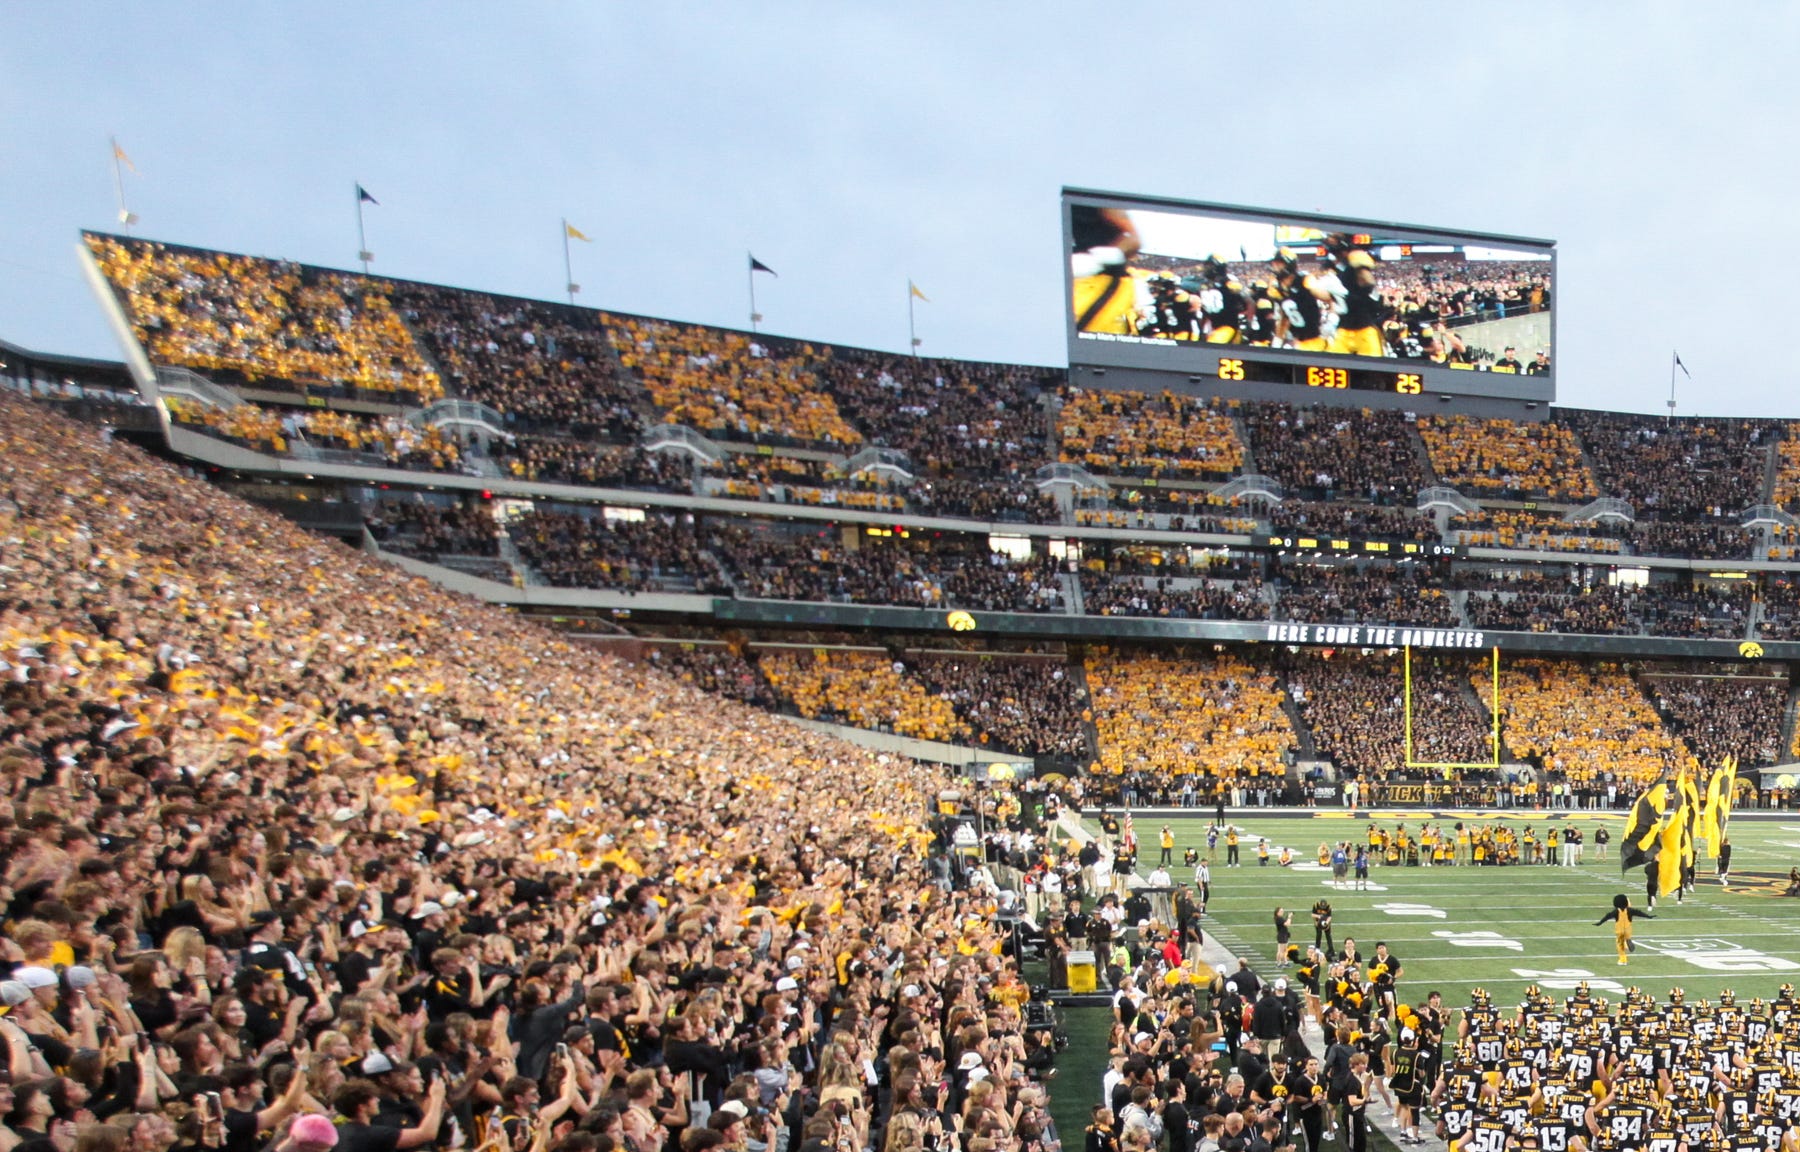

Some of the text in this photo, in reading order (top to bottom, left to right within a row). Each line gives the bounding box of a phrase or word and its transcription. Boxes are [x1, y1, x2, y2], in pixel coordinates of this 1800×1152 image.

[1218, 358, 1245, 381] 25
[1307, 367, 1348, 389] 6:33
[1396, 374, 1421, 395] 25
[1268, 625, 1484, 648] HERE COME THE HAWKEYES
[1477, 1041, 1502, 1061] 60
[1506, 1067, 1531, 1087] 43
[1566, 1054, 1592, 1077] 79
[1445, 1110, 1473, 1134] 84
[1612, 1117, 1642, 1141] 84
[1541, 1127, 1566, 1151] 13
